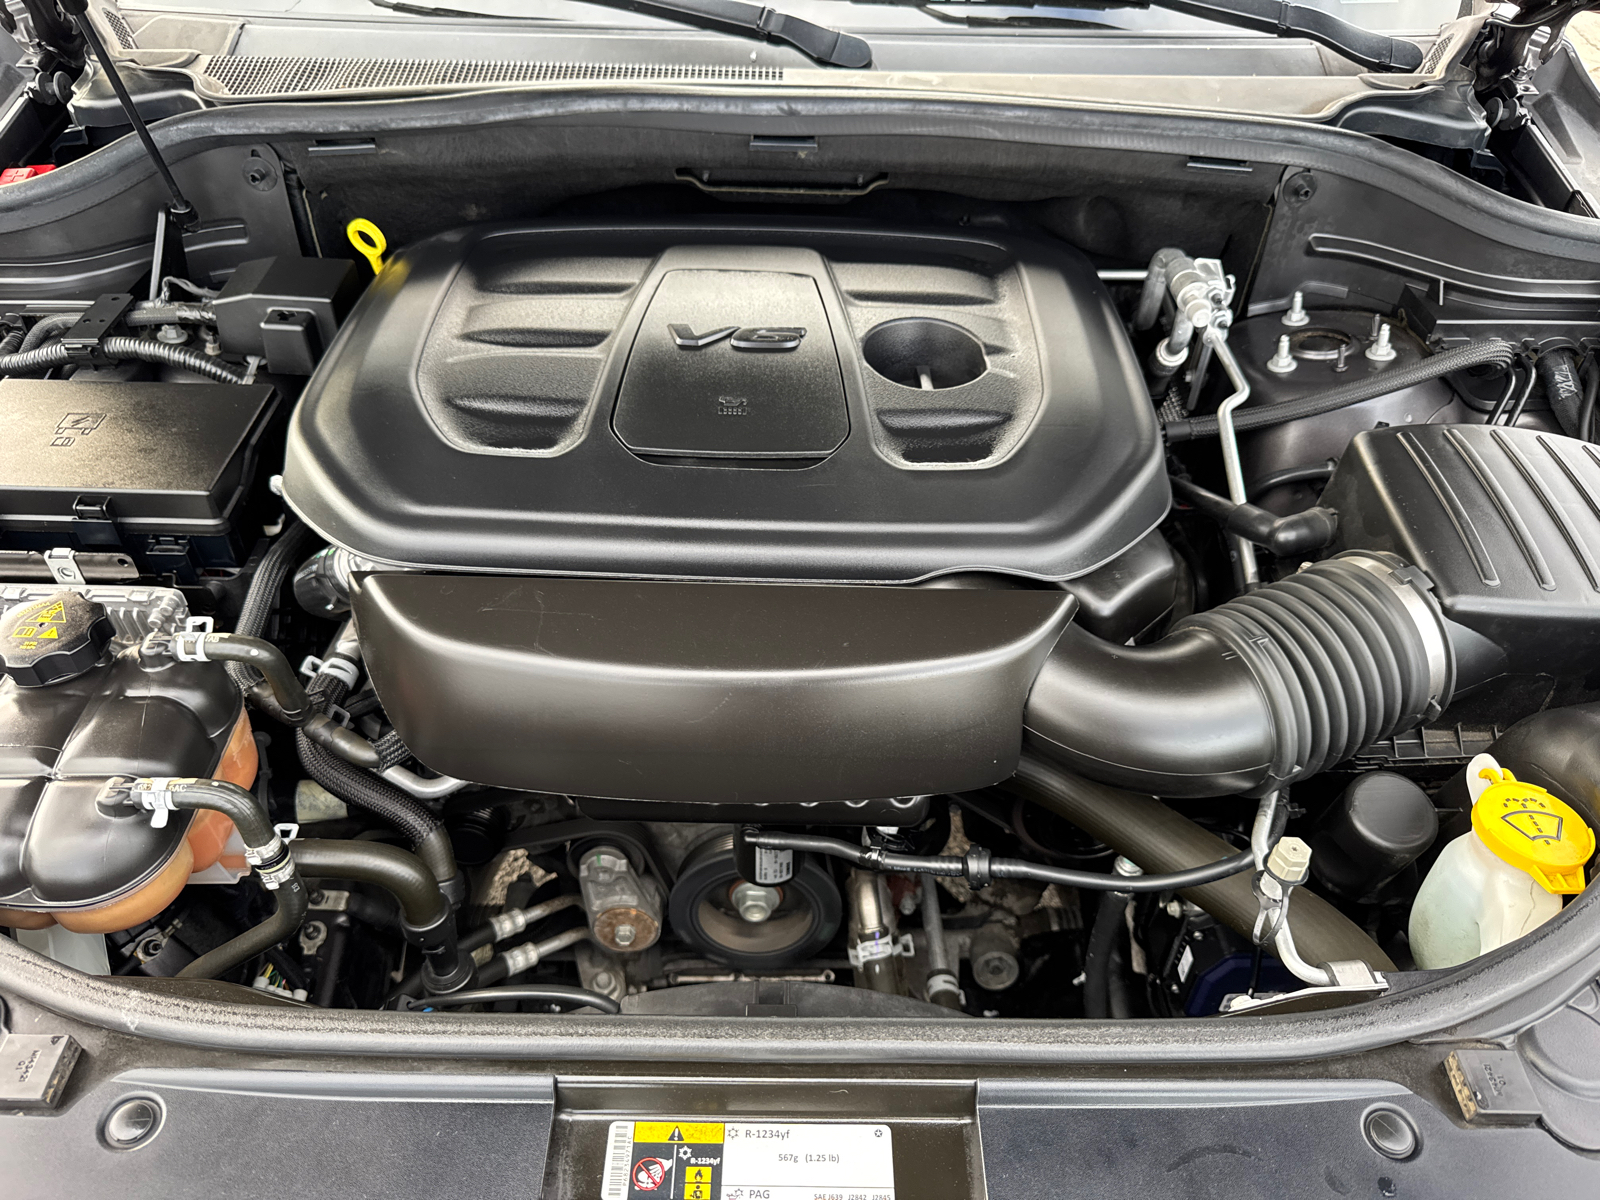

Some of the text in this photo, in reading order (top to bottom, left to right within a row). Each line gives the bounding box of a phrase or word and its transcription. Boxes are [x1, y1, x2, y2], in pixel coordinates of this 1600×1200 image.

[667, 323, 807, 350] V6
[745, 1129, 790, 1140] R-1234yf
[690, 1157, 720, 1166] R-1234yf
[778, 1153, 840, 1164] 567g (1.25 lb)
[749, 1189, 770, 1199] PAG
